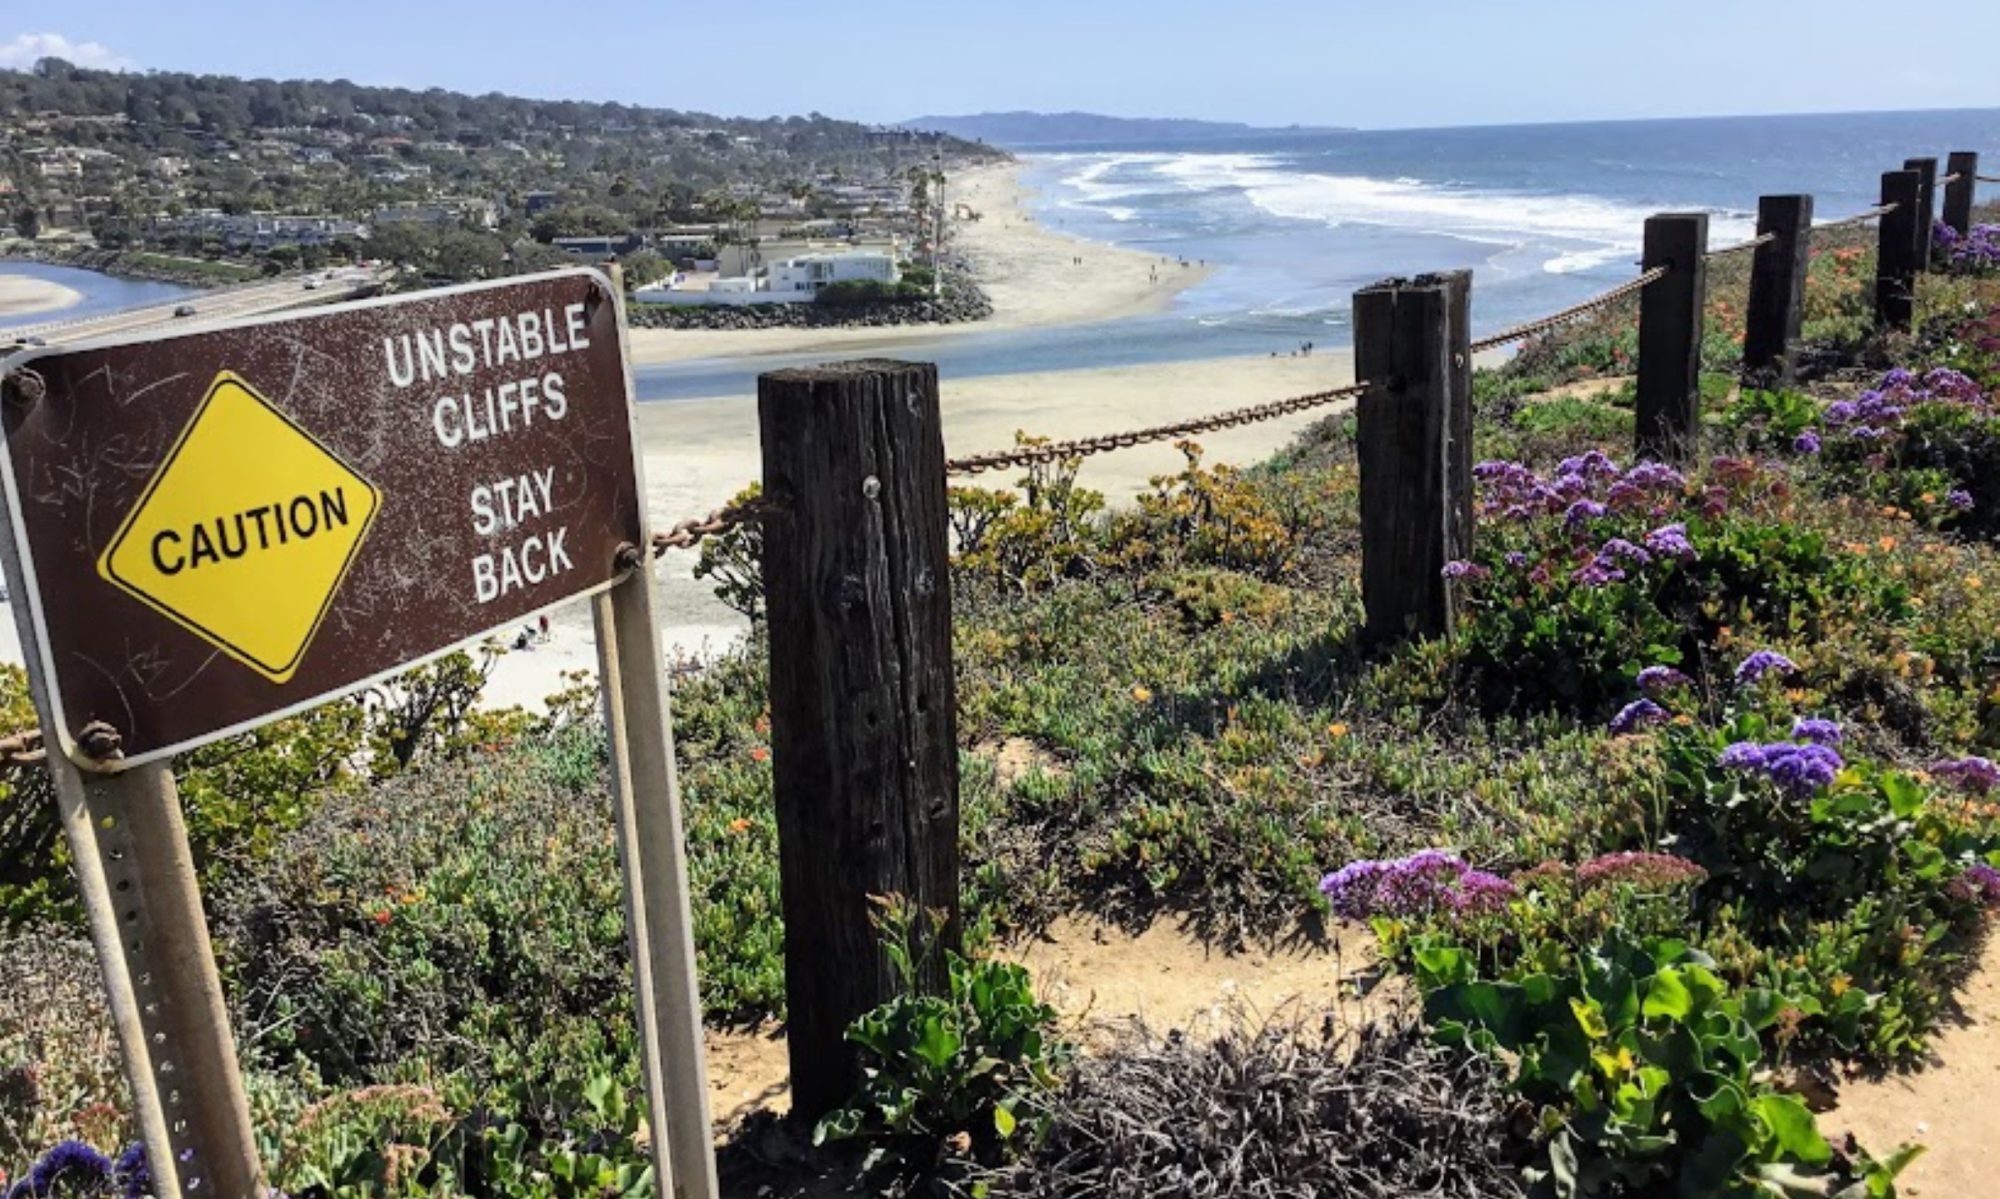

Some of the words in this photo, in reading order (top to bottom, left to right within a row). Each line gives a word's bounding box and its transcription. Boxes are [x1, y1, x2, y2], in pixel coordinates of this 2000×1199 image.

[385, 303, 589, 388] UNSTABLE
[432, 373, 566, 448] CLIFFS
[151, 487, 348, 576] CAUTION
[471, 467, 555, 536] STAY
[472, 527, 573, 604] BACK
